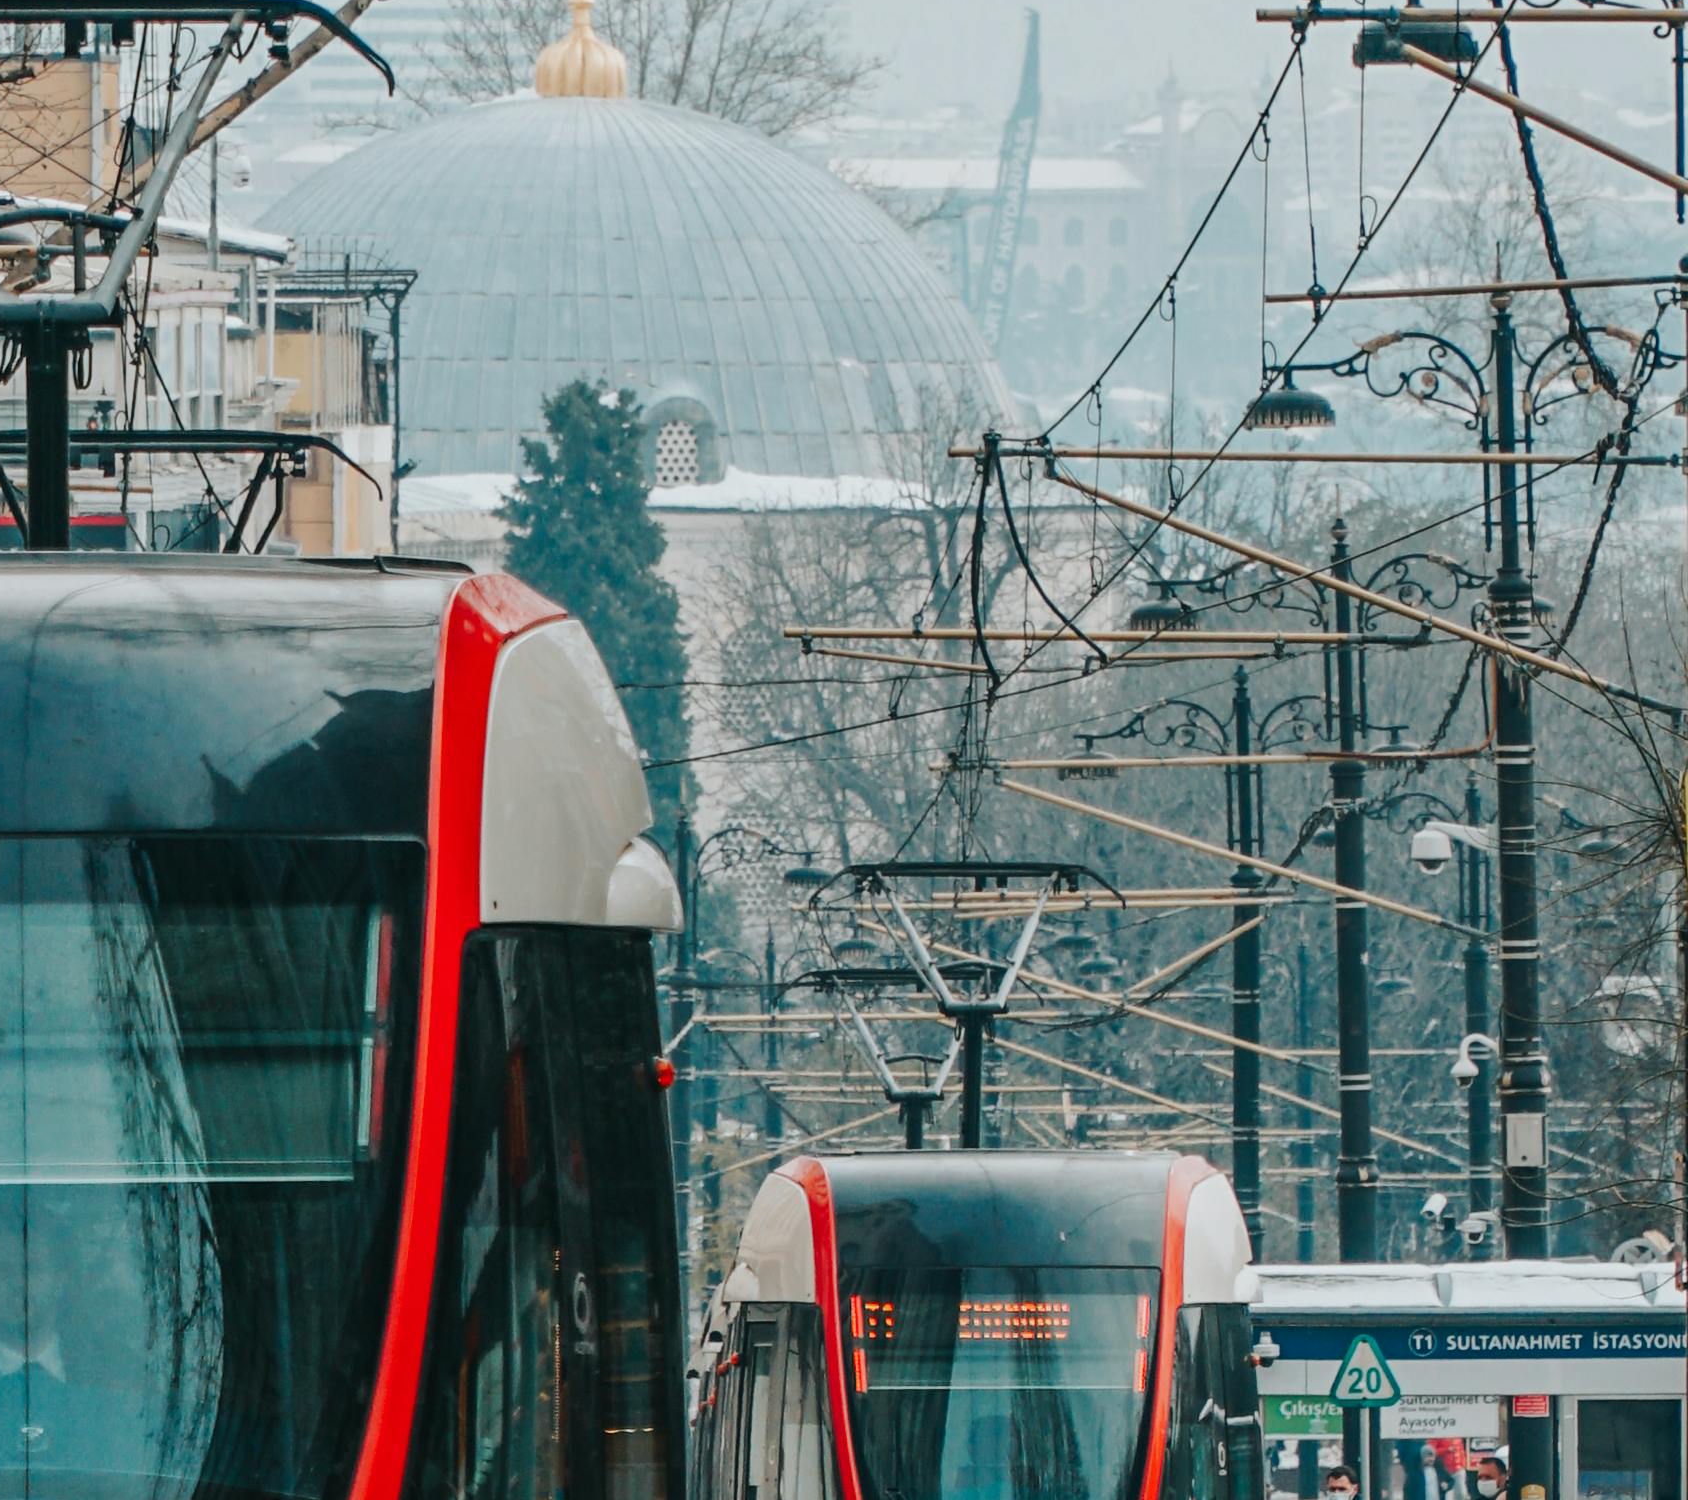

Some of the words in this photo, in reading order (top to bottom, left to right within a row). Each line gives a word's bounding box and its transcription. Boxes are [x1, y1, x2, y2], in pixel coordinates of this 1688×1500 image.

[1413, 1334, 1433, 1350] T1
[1446, 1334, 1583, 1351] SULTANAHMET
[1348, 1367, 1382, 1393] 20
[1399, 1416, 1456, 1429] Ayasofya
